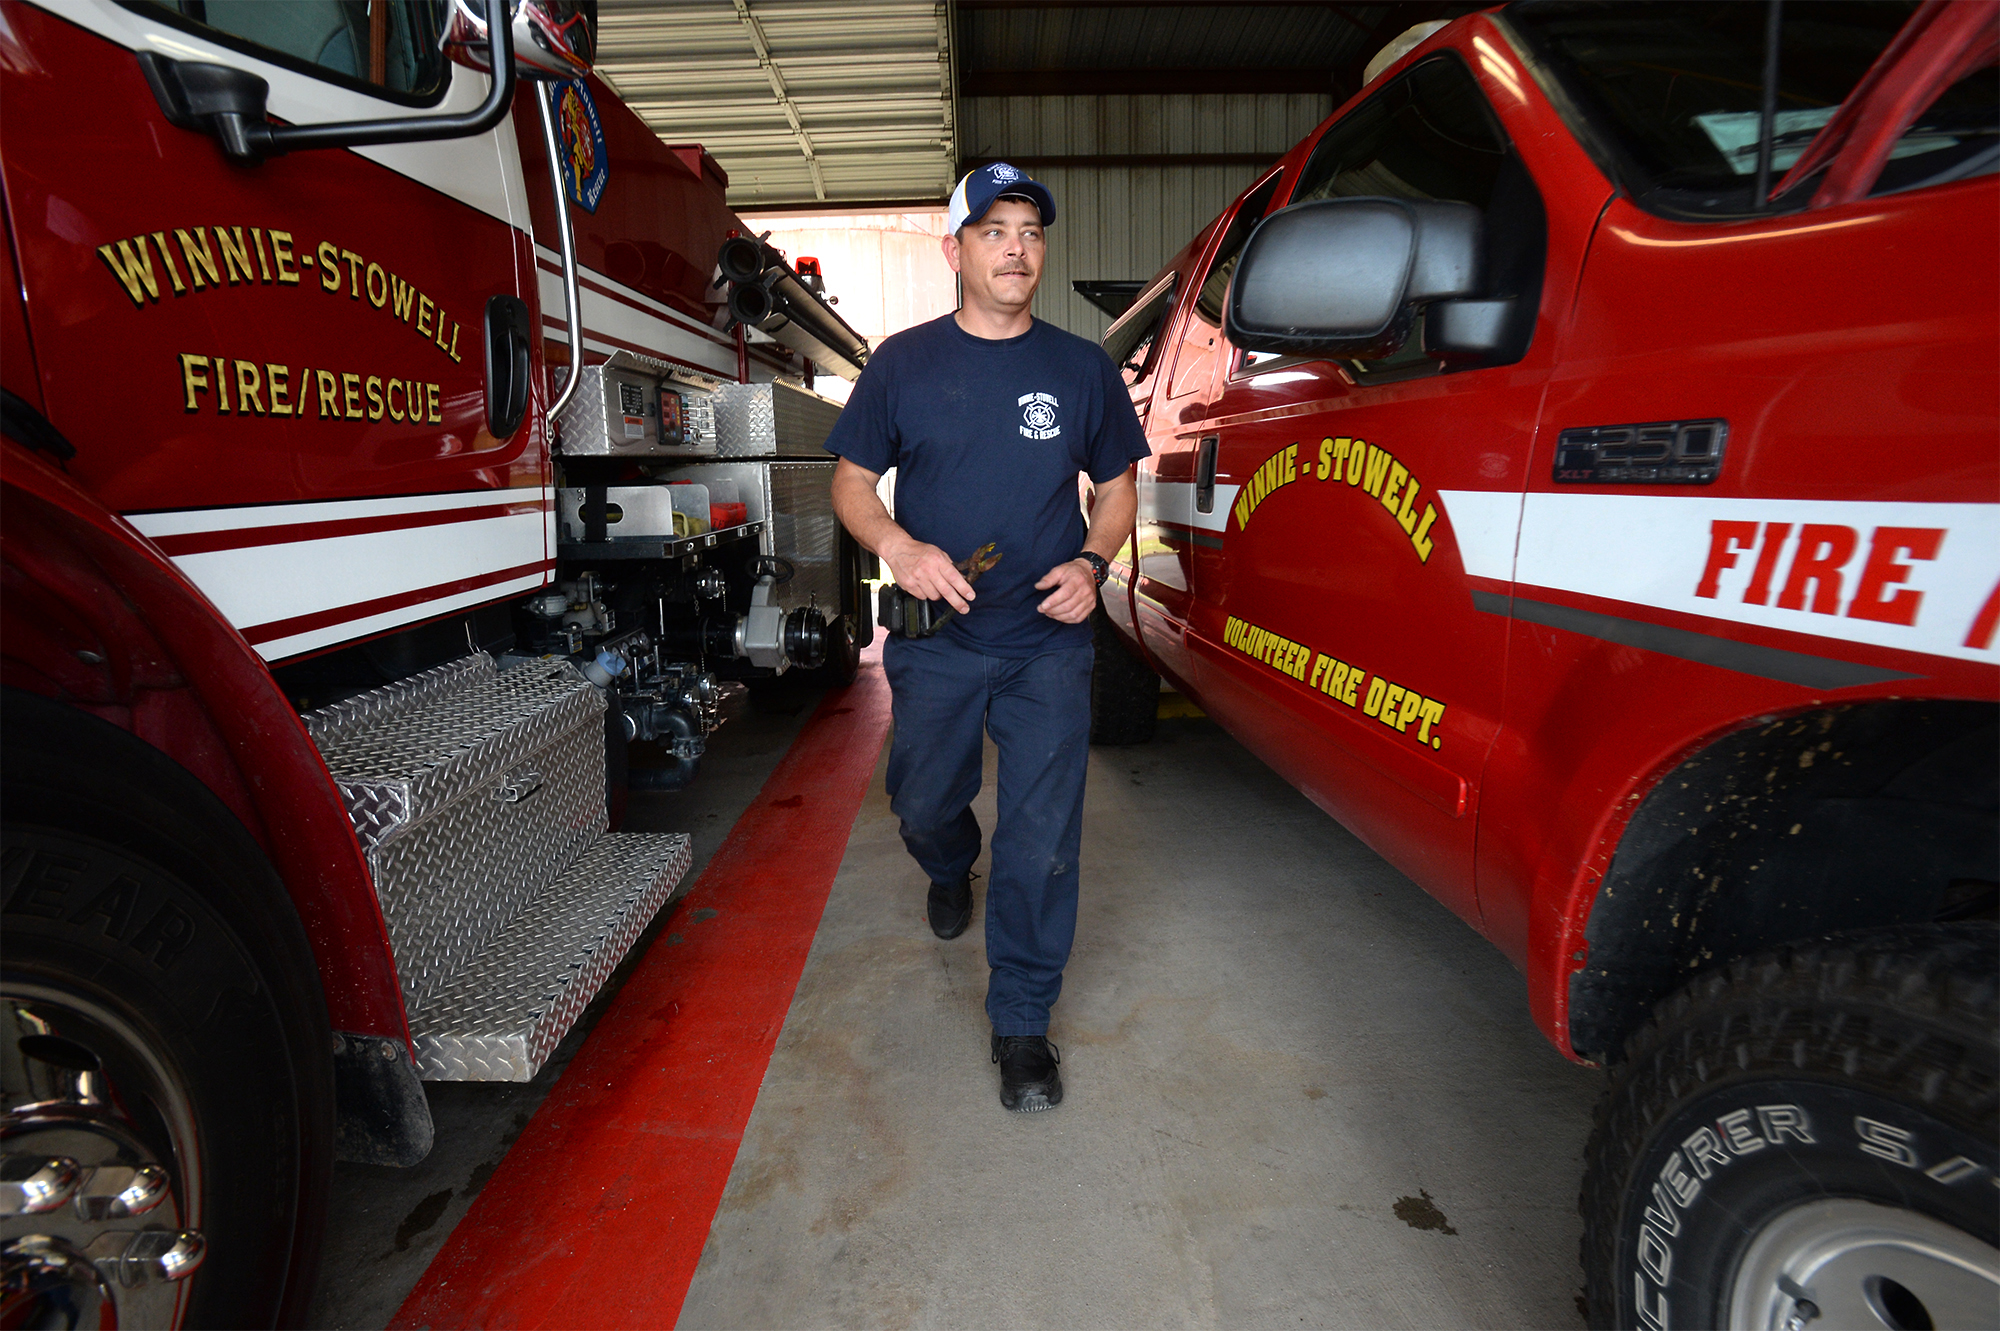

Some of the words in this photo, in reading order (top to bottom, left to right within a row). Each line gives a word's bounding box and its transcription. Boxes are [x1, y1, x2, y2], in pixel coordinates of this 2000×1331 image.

[97, 226, 462, 364] WINNIE-STOWELL
[179, 352, 443, 424] FIRE/RESCUE
[1019, 425, 1033, 439] FIRE
[1233, 441, 1299, 533] WINNIE
[1315, 436, 1439, 566] STOWELL
[1557, 469, 1594, 480] XLT
[1693, 519, 1949, 628] FIRE
[1223, 614, 1311, 682] VOLUNTEER
[1309, 652, 1367, 708] FIRE
[1362, 675, 1447, 751] DEPT.
[1634, 1104, 1818, 1331] COVERER
[1853, 1115, 2000, 1190] S/
